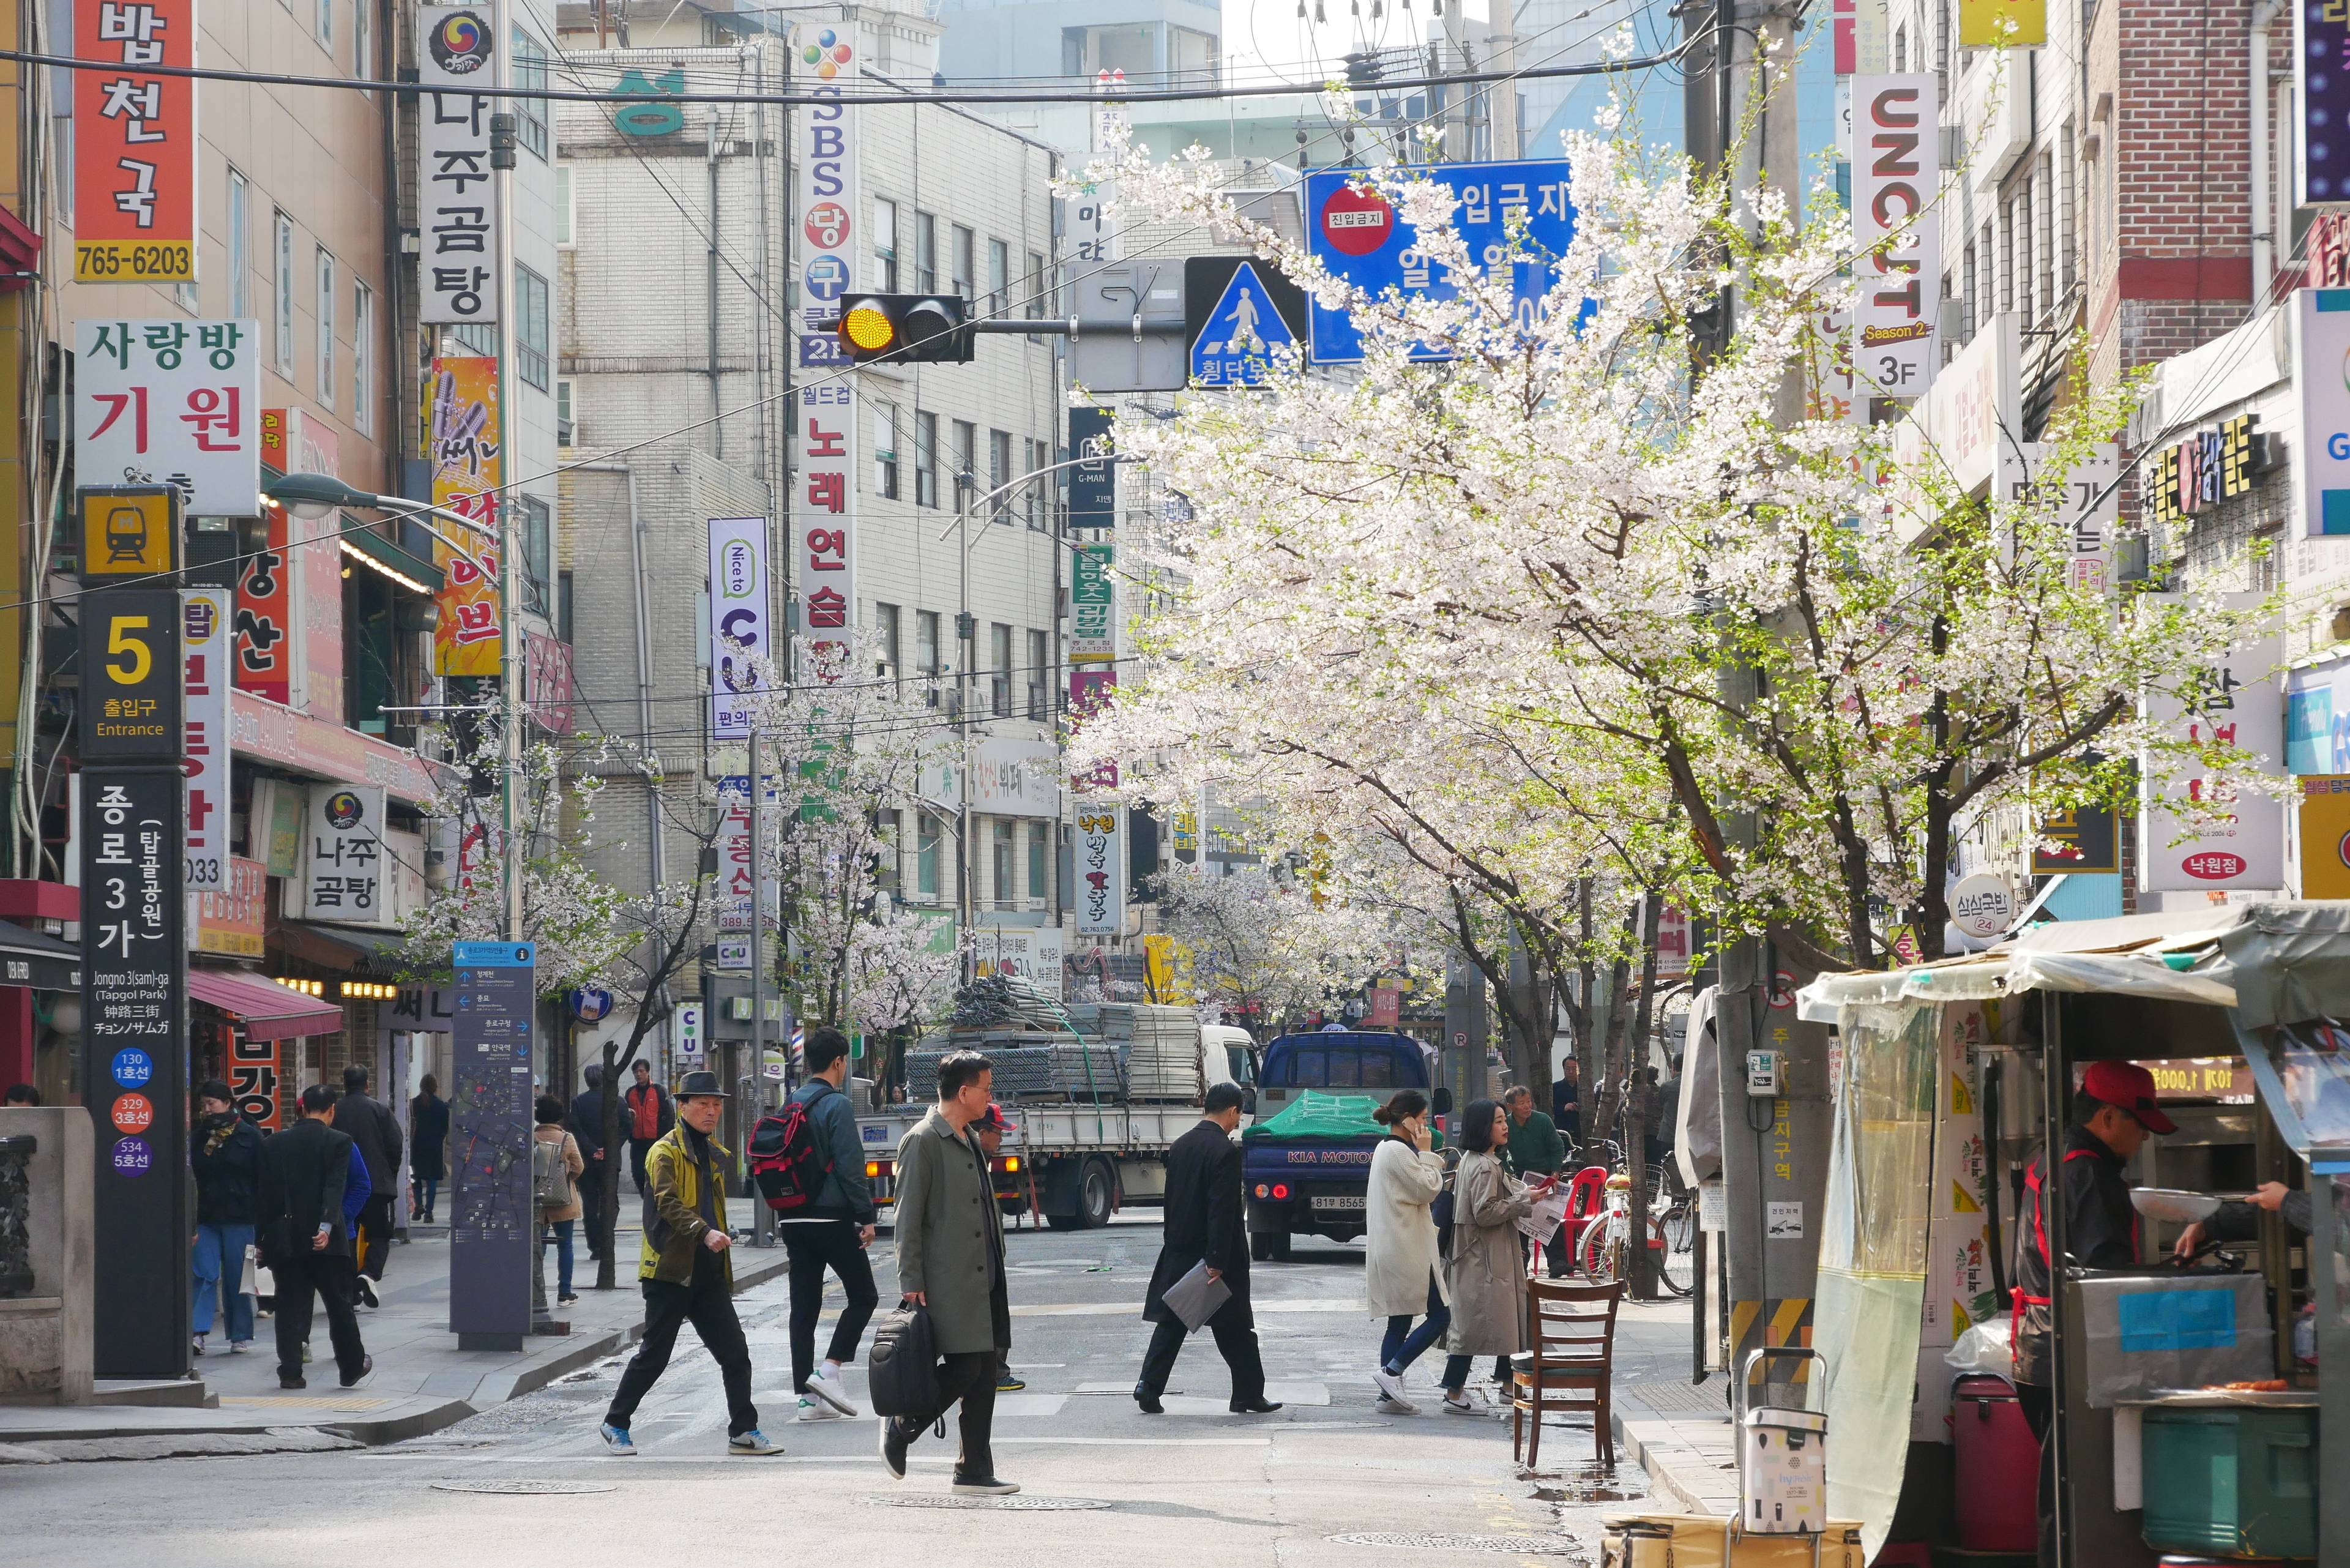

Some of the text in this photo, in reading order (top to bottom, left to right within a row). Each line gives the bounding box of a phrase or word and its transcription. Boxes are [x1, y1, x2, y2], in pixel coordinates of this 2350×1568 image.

[810, 86, 845, 196] SBS
[431, 92, 490, 315] 나주곰탕
[1445, 181, 1567, 224] 입금지
[1871, 88, 1921, 319] UNCUT
[1331, 212, 1381, 226] 진입금지
[78, 244, 189, 275] 765-6203
[812, 208, 845, 298] 당구
[1865, 323, 1926, 341] Season 2
[87, 322, 244, 370] 사랑방
[1201, 359, 1291, 383] 횡단보
[1879, 356, 1917, 386] 3F
[802, 387, 851, 405] 월드컵
[88, 386, 241, 454] 기원
[1095, 495, 1111, 504] 지맨
[732, 547, 744, 592] Nice to
[105, 616, 151, 684] 5
[103, 699, 157, 717] 출입구
[97, 723, 163, 736] Entrance
[1078, 814, 1116, 835] 낙원
[316, 837, 377, 867] 나주
[95, 786, 135, 958] 종로3가
[2190, 857, 2237, 874] 낙원점
[139, 819, 164, 939] (탑골공원)
[313, 876, 376, 908] 곰탕
[1957, 892, 2009, 917] 삼삼국밥
[1977, 919, 1993, 930] 24
[93, 970, 125, 989] Jongno
[127, 970, 169, 988] 3(sam)-ga
[95, 989, 167, 1002] (Tapgol Park)
[104, 1005, 160, 1018] 钟路三街
[94, 1021, 169, 1035] チョンノサムガ
[491, 1043, 510, 1052] 안국역
[122, 1054, 142, 1064] 130
[116, 1067, 149, 1080] 1호선
[122, 1099, 143, 1110] 329
[1772, 1028, 1792, 1181] 주금지구역
[115, 1111, 149, 1125] 3호선
[121, 1142, 142, 1152] 534
[114, 1155, 148, 1168] 5호선
[1288, 1151, 1373, 1163] KIA MOTO
[1316, 1198, 1365, 1208] 81무 8565
